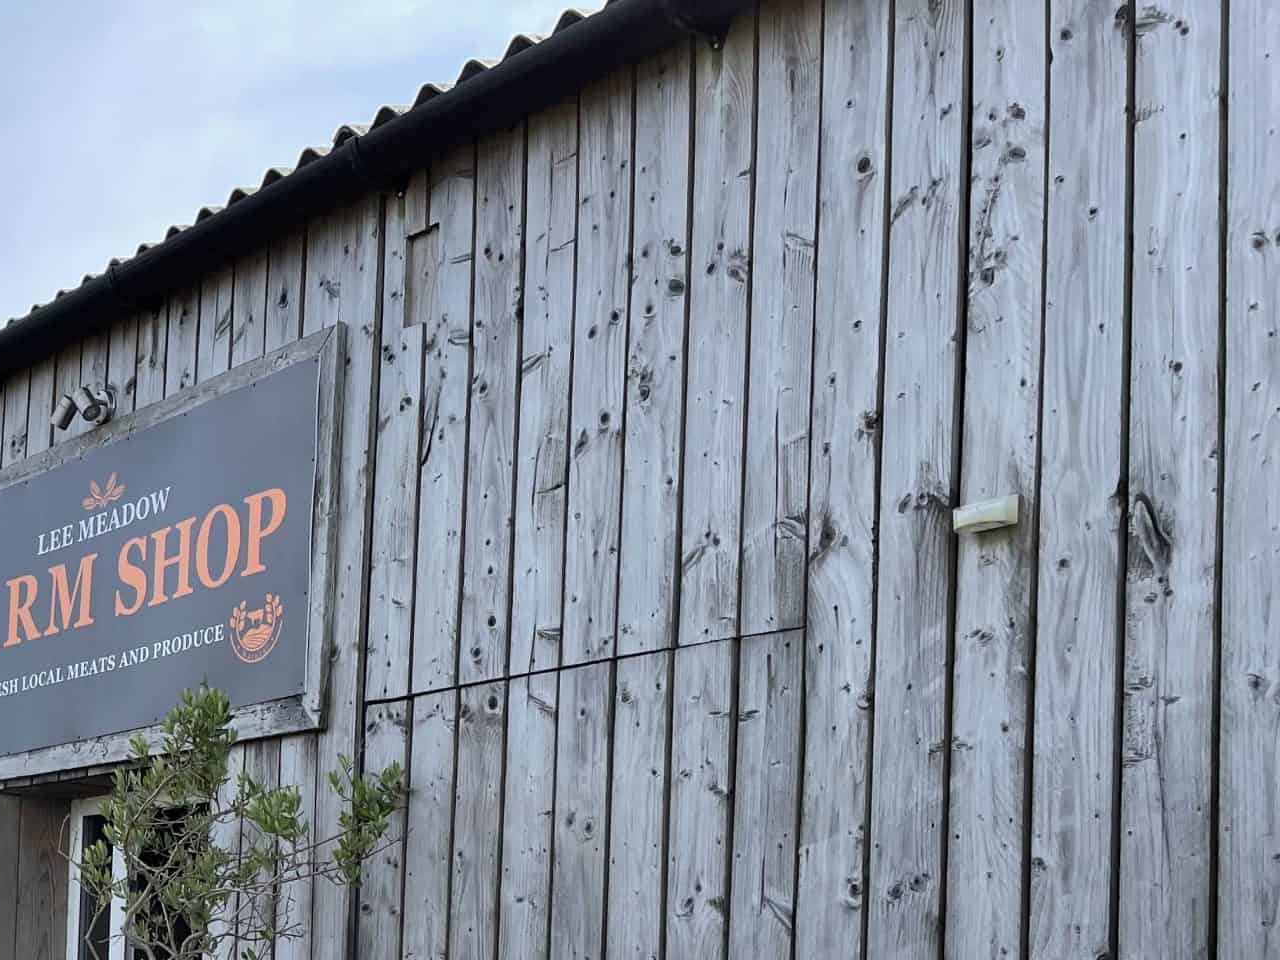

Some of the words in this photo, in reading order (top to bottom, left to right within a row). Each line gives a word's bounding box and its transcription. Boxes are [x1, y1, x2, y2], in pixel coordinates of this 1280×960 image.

[37, 525, 73, 555] LEE
[78, 487, 171, 542] MEADOW
[115, 488, 287, 617] SHOP
[22, 667, 64, 690] LOCAL
[67, 655, 116, 681] MEATS
[119, 646, 150, 668] AND
[154, 624, 225, 659] PRODUCE
